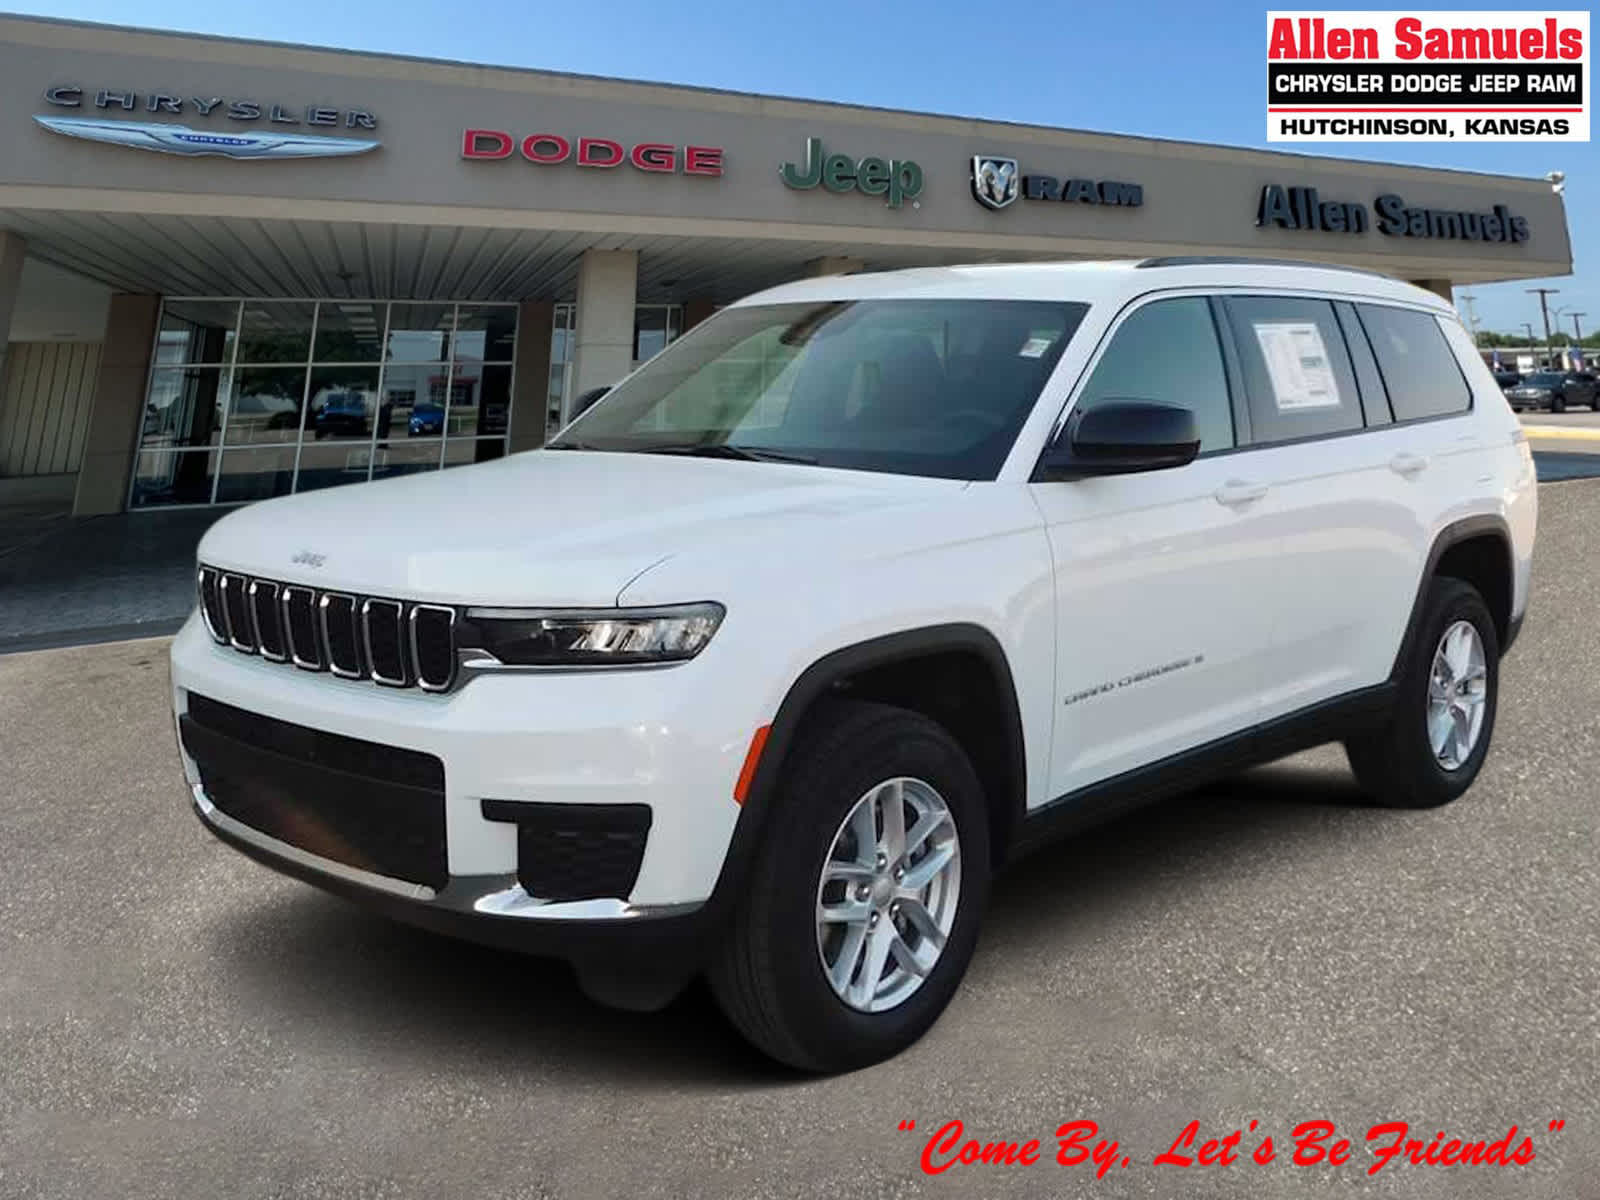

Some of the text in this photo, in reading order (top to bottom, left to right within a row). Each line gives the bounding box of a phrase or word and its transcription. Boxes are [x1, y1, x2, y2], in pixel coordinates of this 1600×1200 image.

[45, 86, 378, 129] CHRYSLER
[461, 128, 725, 177] DODGE
[779, 136, 924, 210] Jeep
[1022, 175, 1144, 208] RAM
[1256, 184, 1531, 243] Allen Samuels
